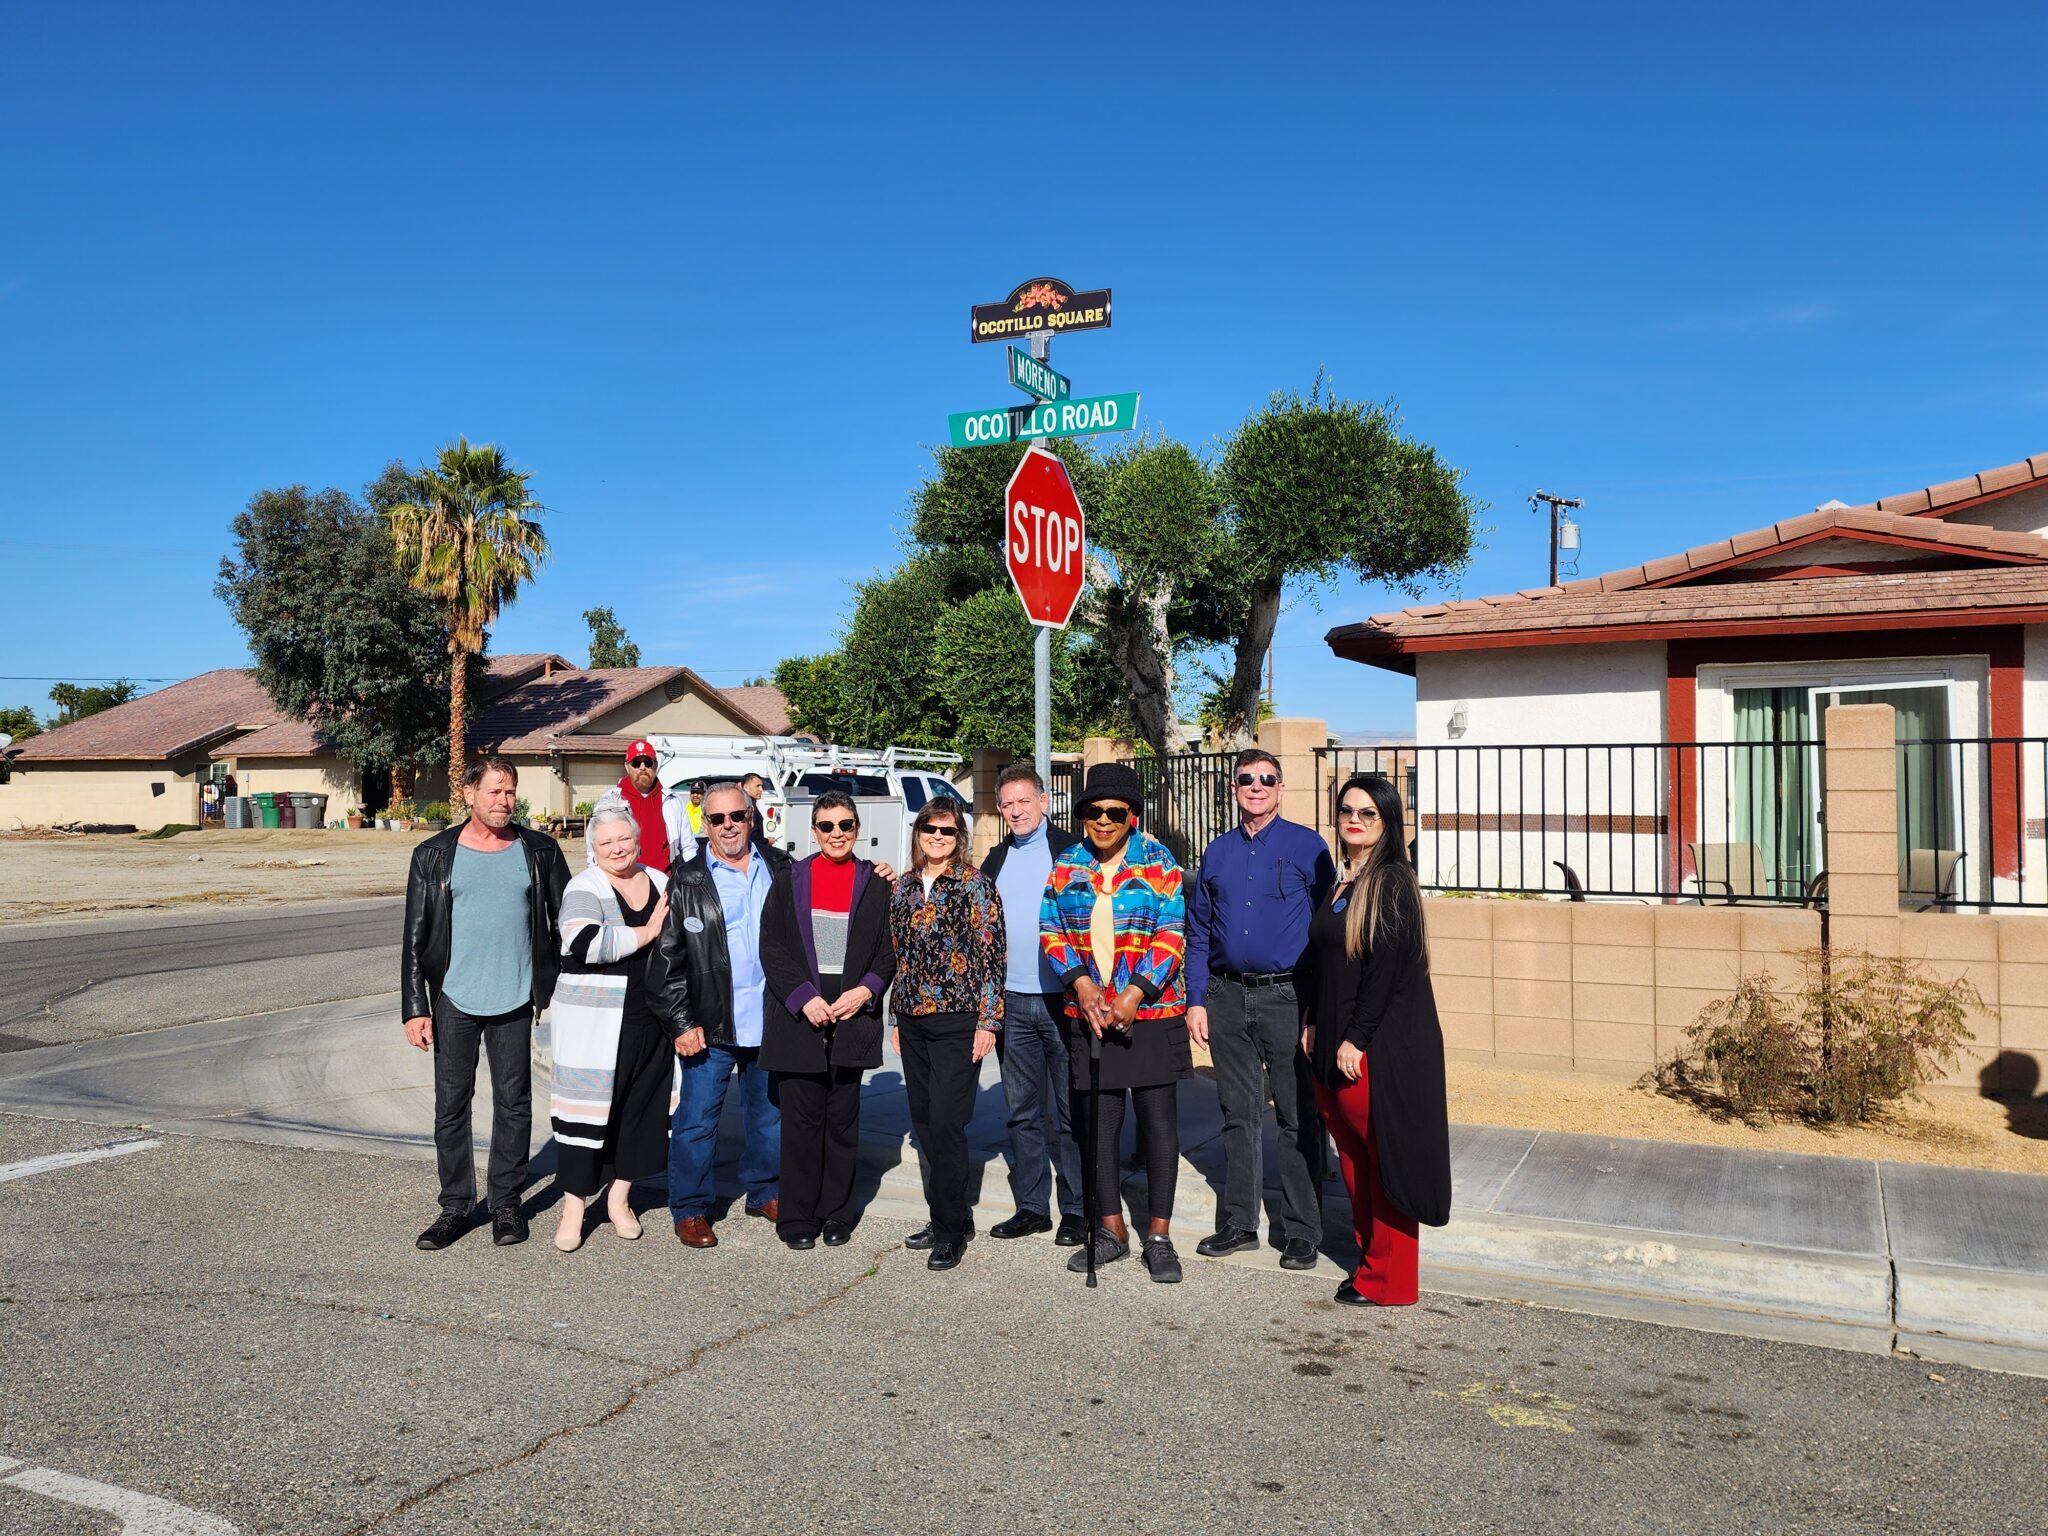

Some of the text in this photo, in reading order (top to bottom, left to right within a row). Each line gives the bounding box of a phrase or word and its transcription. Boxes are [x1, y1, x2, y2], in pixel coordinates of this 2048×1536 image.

[979, 308, 1104, 335] OCOTILLO SQUARE
[1017, 354, 1057, 400] MORENO
[964, 400, 1118, 442] OCOTILLO ROAD
[1012, 500, 1080, 575] STOP
